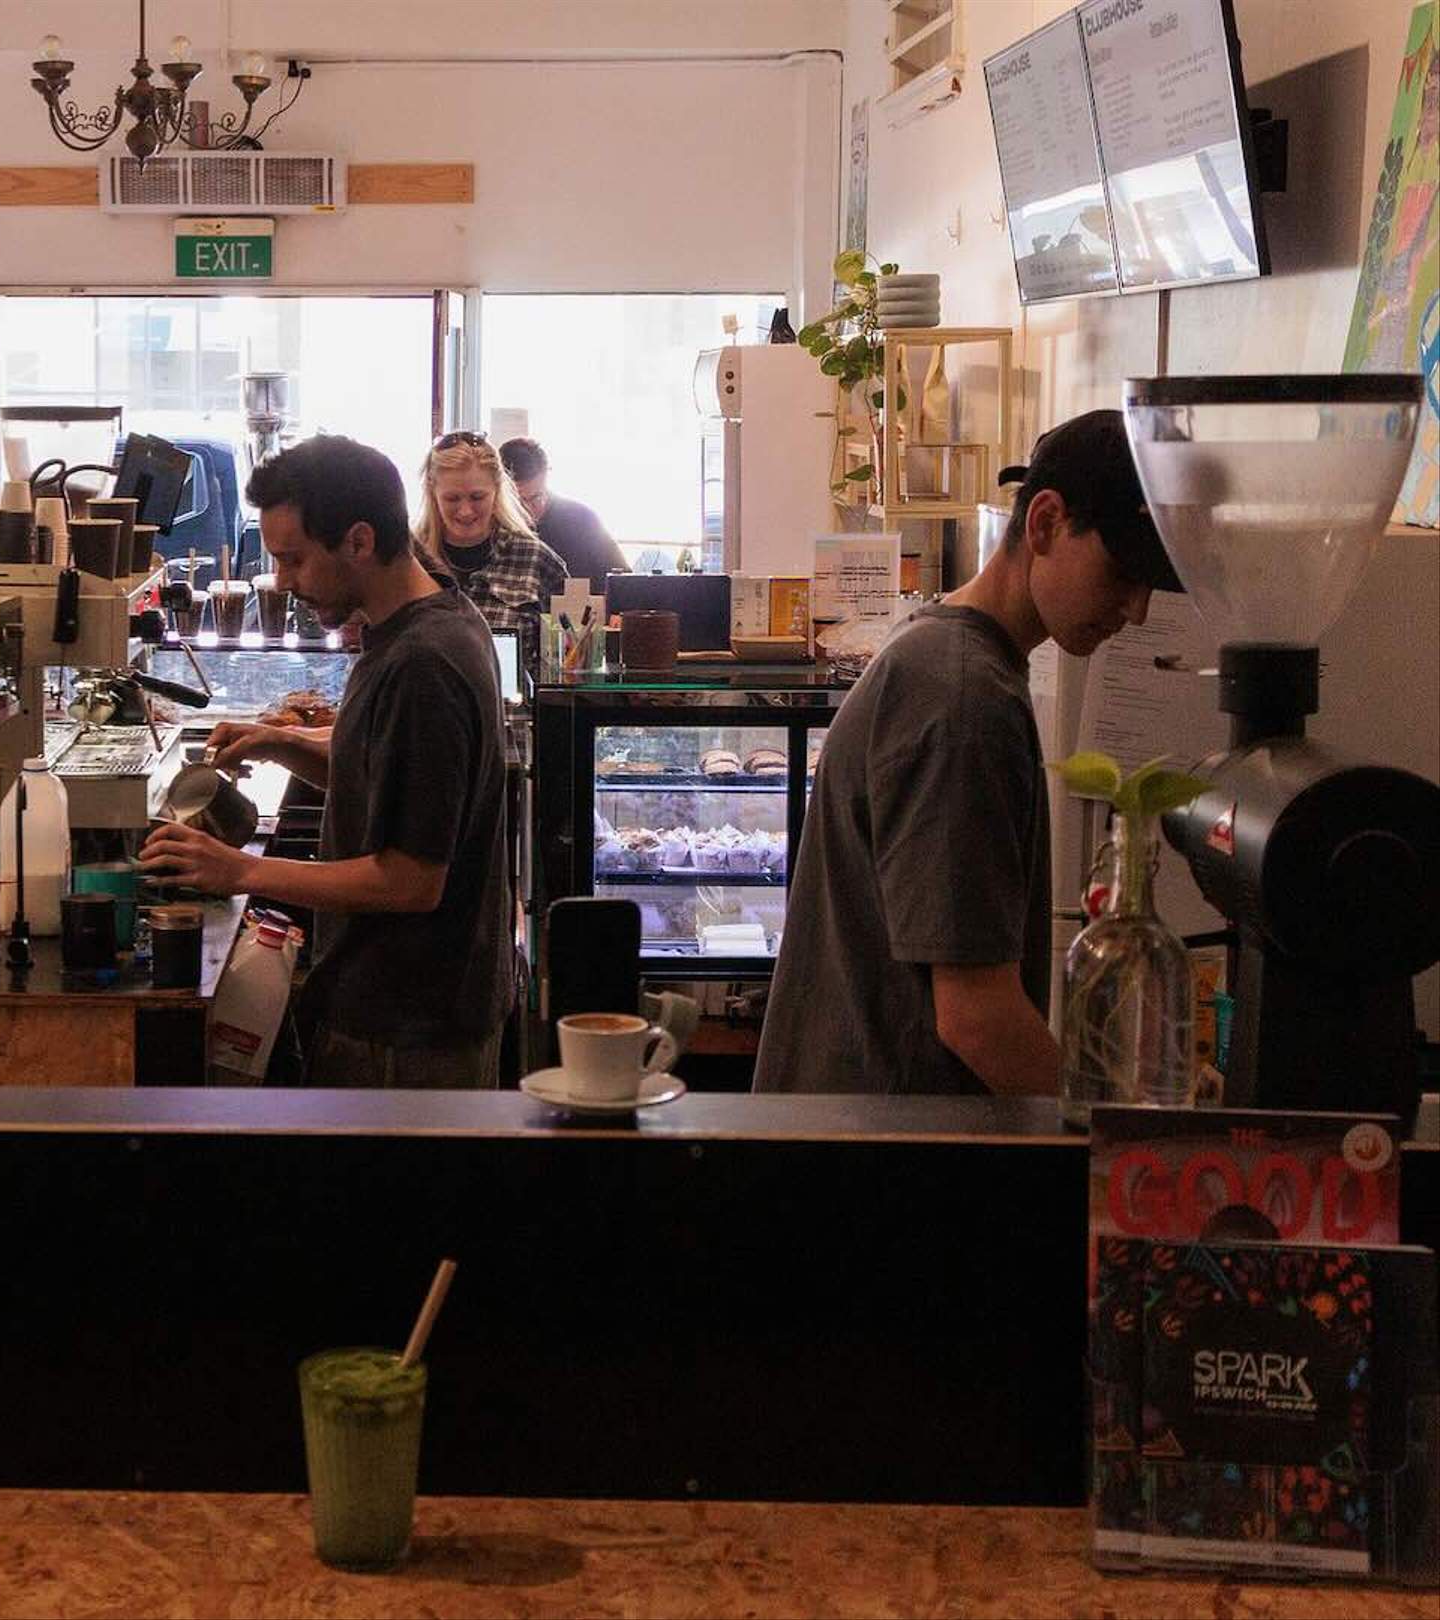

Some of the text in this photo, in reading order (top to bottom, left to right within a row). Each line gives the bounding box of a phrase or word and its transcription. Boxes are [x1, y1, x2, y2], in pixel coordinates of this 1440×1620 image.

[1085, 0, 1144, 37] CLUBHOUSE
[195, 242, 252, 271] EXIT
[1110, 1150, 1380, 1241] GOOD
[1193, 1350, 1313, 1392] SPARK
[1194, 1384, 1266, 1402] IPSWICH
